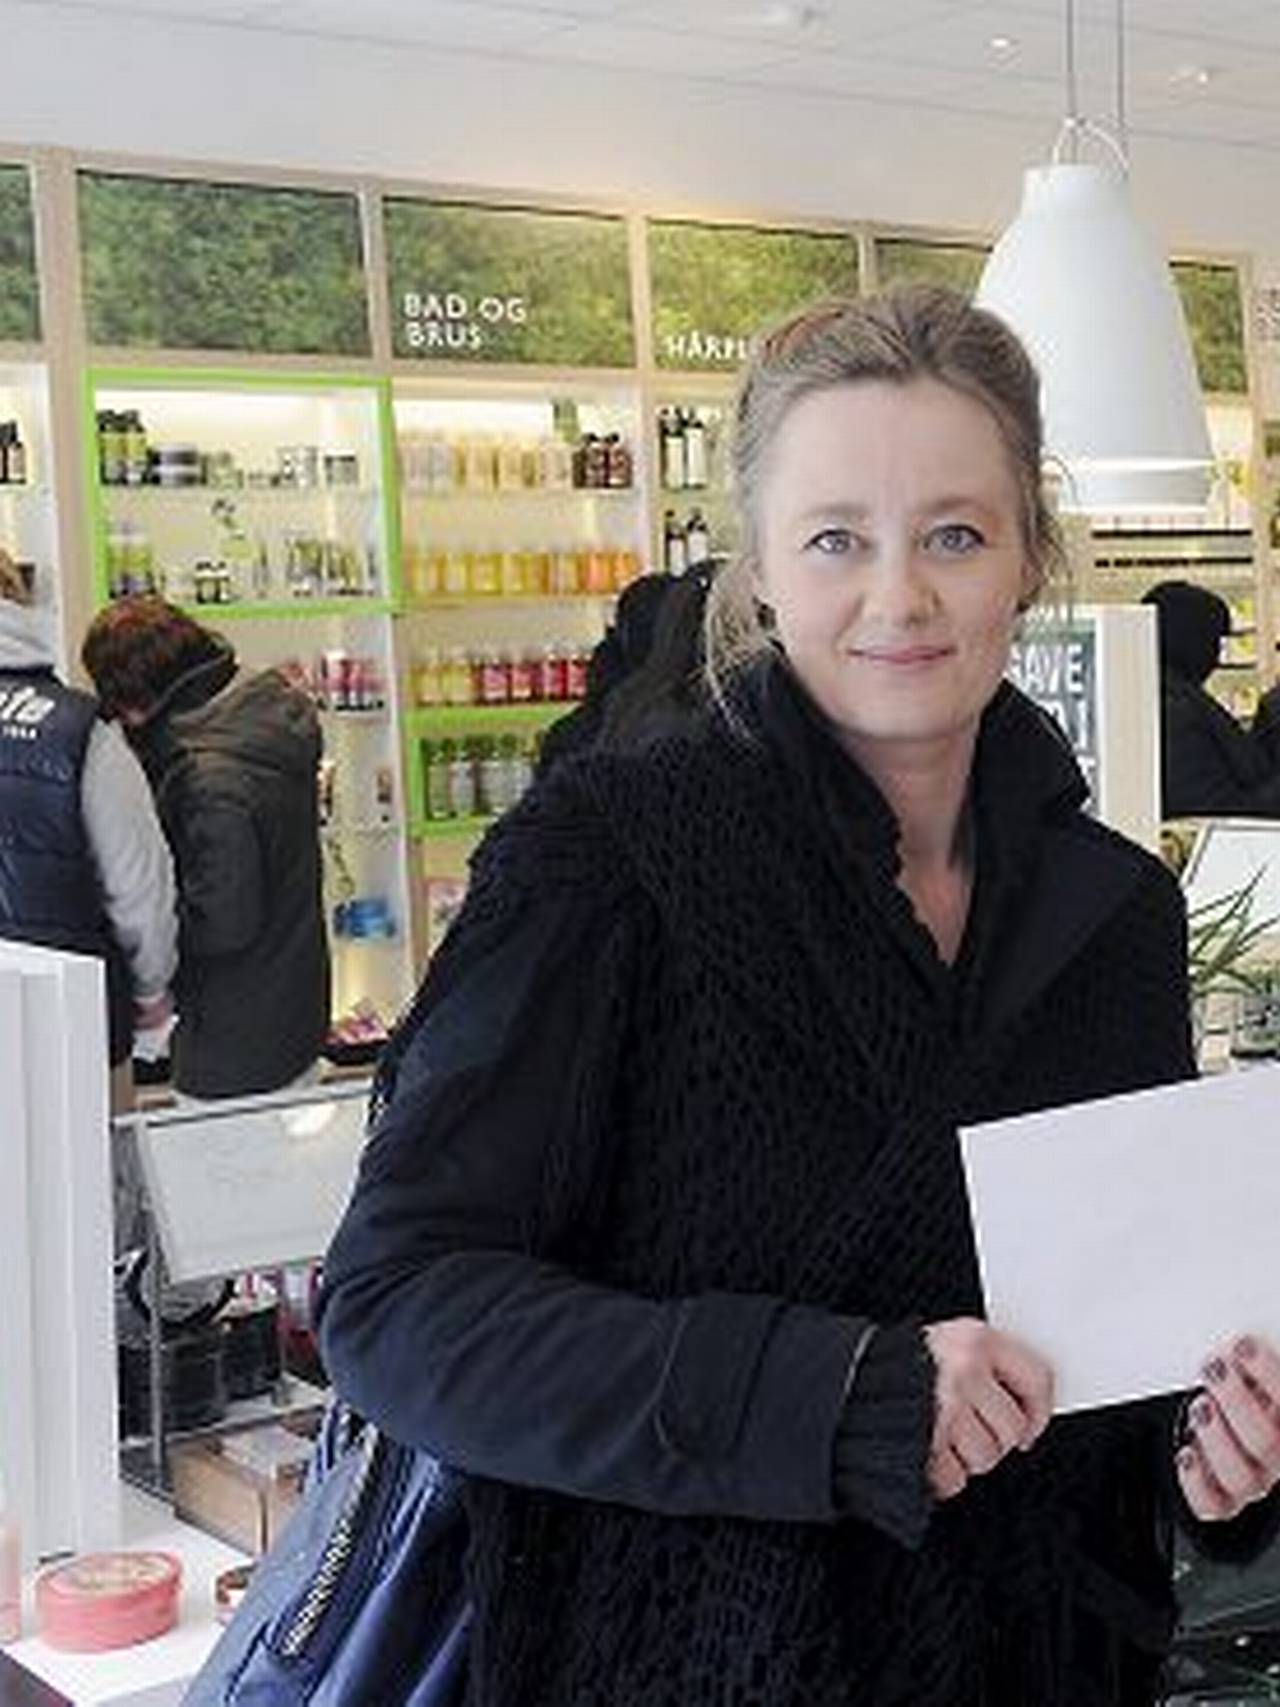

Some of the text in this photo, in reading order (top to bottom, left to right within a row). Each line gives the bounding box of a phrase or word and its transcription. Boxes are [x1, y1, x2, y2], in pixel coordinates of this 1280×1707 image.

[404, 293, 527, 322] BAD OG
[405, 321, 481, 350] BRUS
